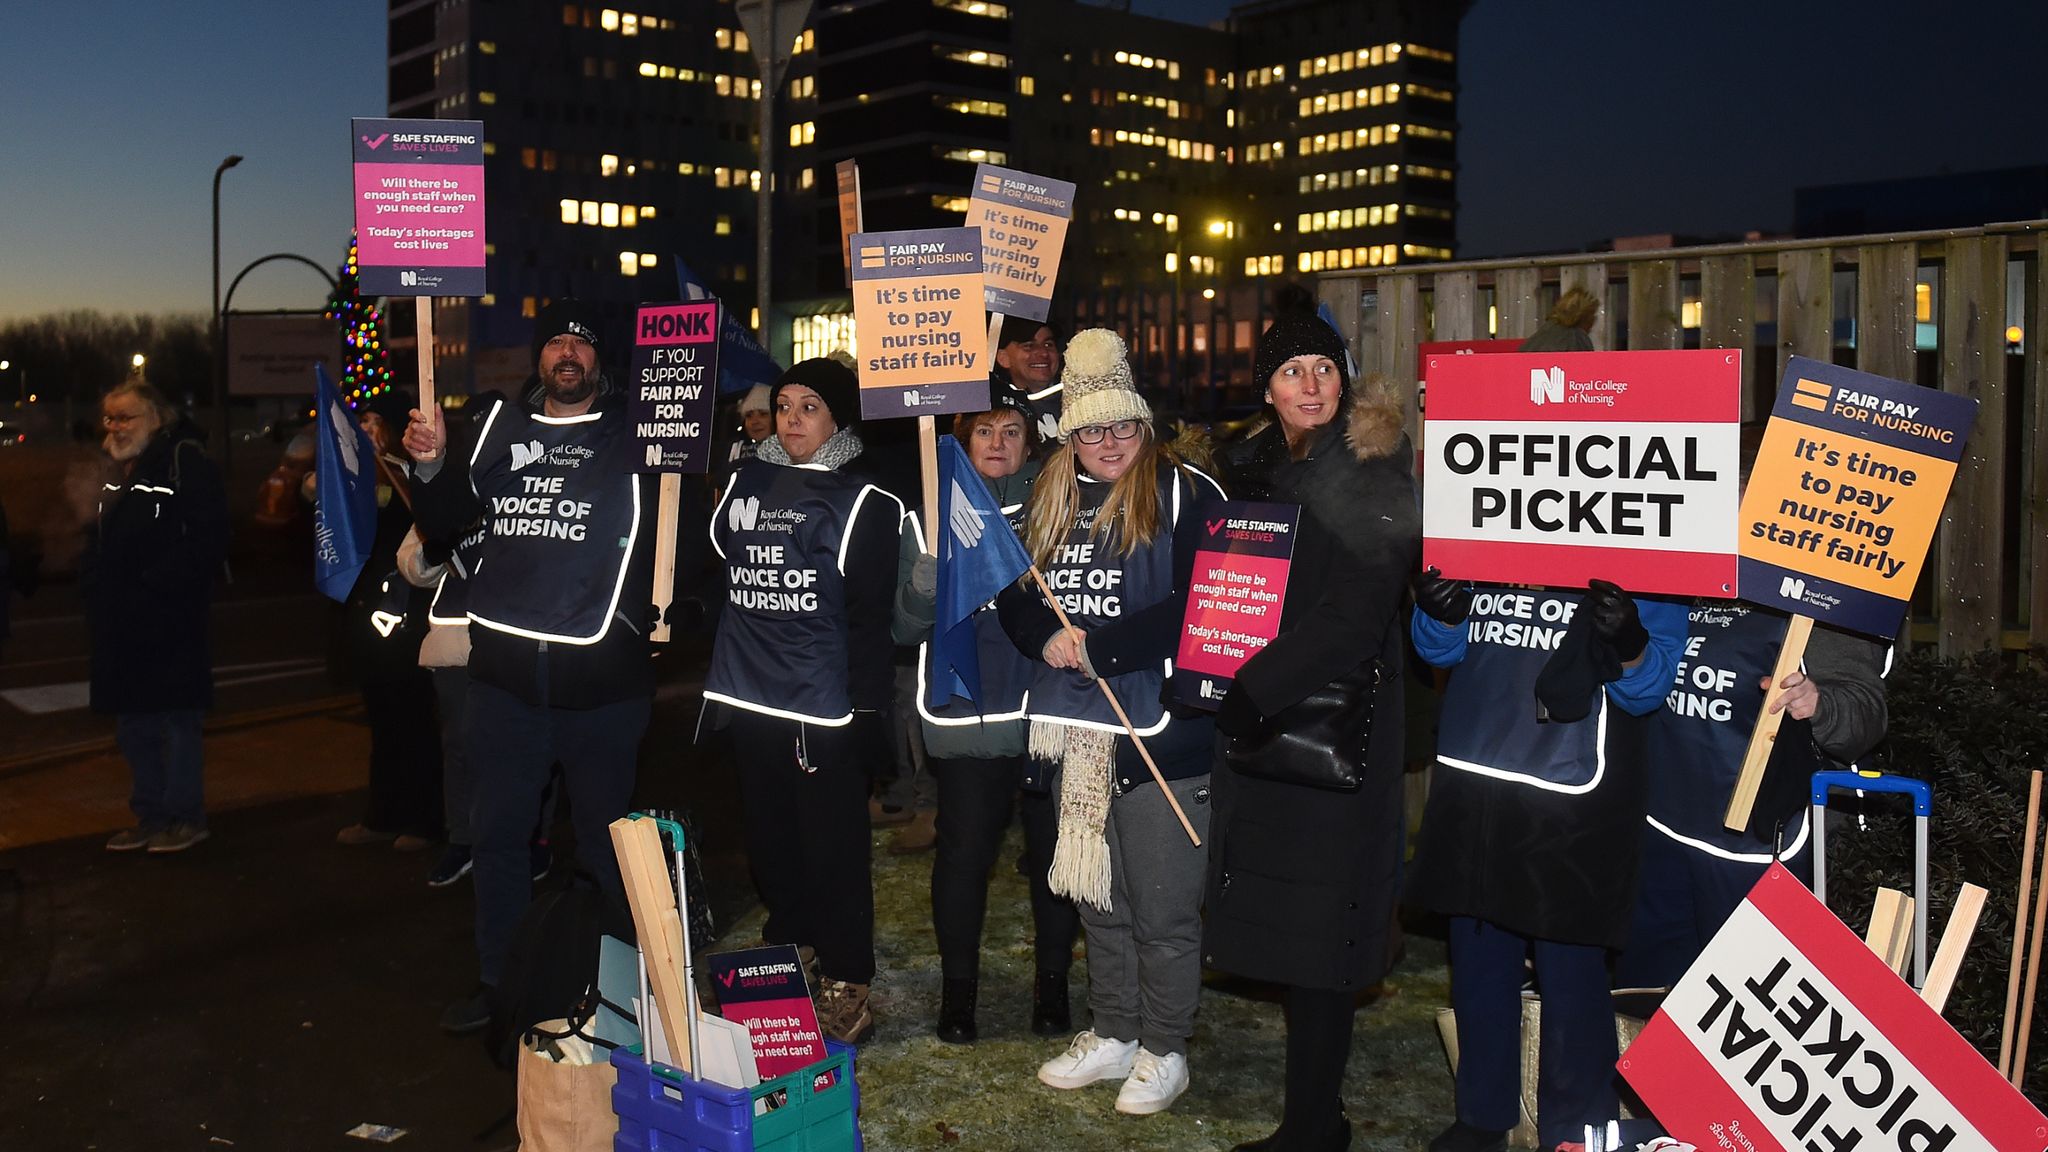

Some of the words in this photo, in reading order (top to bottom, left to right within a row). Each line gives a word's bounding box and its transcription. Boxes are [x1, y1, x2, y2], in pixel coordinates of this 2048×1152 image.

[393, 133, 421, 143] SAFE
[423, 134, 475, 144] STAFFING
[393, 144, 427, 152] SAVES
[430, 144, 458, 152] LIVES
[382, 178, 406, 188] Will
[409, 179, 440, 189] there
[444, 179, 458, 189] be
[1004, 180, 1026, 192] FAIR
[1027, 184, 1047, 195] PAY
[364, 192, 409, 202] enough
[412, 192, 440, 201] staff
[442, 192, 475, 202] when
[1002, 188, 1022, 199] FOR
[1023, 193, 1065, 209] NURSING
[376, 205, 398, 214] you
[401, 204, 430, 213] need
[433, 204, 464, 213] care?
[984, 209, 1008, 225] It's
[1012, 215, 1049, 233] time
[368, 227, 412, 238] Today's
[415, 228, 474, 239] shortages
[989, 228, 1005, 241] to
[1008, 233, 1038, 250] pay
[394, 240, 419, 249] cost
[422, 240, 448, 249] lives
[889, 245, 917, 256] FAIR
[920, 243, 945, 254] PAY
[890, 256, 916, 266] FOR
[918, 252, 974, 265] NURSING
[982, 261, 1004, 275] aff
[1006, 265, 1047, 287] fairly
[876, 287, 908, 305] It's
[912, 286, 961, 303] time
[641, 312, 710, 338] HONK
[888, 312, 909, 326] to
[915, 309, 952, 328] pay
[882, 329, 961, 349] nursing
[652, 350, 664, 364] IF
[666, 348, 695, 363] YOU
[869, 352, 918, 371] staff
[922, 350, 976, 369] fairly
[641, 366, 704, 383] SUPPORT
[640, 386, 672, 401] FAIR
[674, 385, 702, 400] PAY
[1568, 379, 1593, 391] Royal
[1594, 379, 1628, 393] College
[1568, 393, 1579, 404] of
[1580, 393, 1615, 406] Nursing
[1836, 388, 1880, 410] FAIR
[1881, 398, 1920, 419] PAY
[655, 404, 683, 419] FOR
[637, 422, 700, 438] NURSING
[1832, 403, 1868, 423] FOR
[1872, 413, 1954, 444] NURSING
[565, 444, 595, 458] College
[1443, 432, 1717, 481] OFFICIAL
[538, 455, 548, 464] of
[549, 456, 581, 469] Nursing
[1794, 437, 1840, 467] It's
[1847, 452, 1917, 487] time
[522, 476, 565, 494] THE
[1800, 470, 1831, 495] to
[1835, 483, 1894, 515] pay
[492, 497, 554, 515] VOICE
[557, 499, 592, 520] OF
[760, 509, 778, 522] Royal
[778, 509, 807, 524] College
[1075, 506, 1096, 520] oyal
[1472, 487, 1684, 537] PICKET
[493, 518, 587, 541] NURSING
[757, 522, 767, 532] of
[767, 521, 793, 535] Nursing
[1226, 519, 1248, 530] SAFE
[1249, 520, 1289, 533] STAFFING
[1779, 498, 1894, 547] nursing
[1225, 530, 1250, 540] SAVES
[1251, 532, 1274, 542] LIVES
[746, 545, 785, 565] THE
[1052, 543, 1094, 564] THE
[1750, 521, 1823, 552] staff
[1826, 538, 1906, 579] fairly
[730, 566, 780, 588] VOICE
[783, 569, 817, 588] OF
[1037, 569, 1083, 592] OICE
[1087, 569, 1123, 590] OF
[1208, 569, 1226, 580] Will
[1227, 570, 1252, 584] there
[1254, 574, 1267, 585] be
[730, 589, 818, 612] NURSING
[1193, 583, 1226, 597] enough
[1227, 585, 1250, 599] staff
[1251, 590, 1278, 603] when
[1197, 599, 1220, 612] you
[1221, 600, 1239, 613] need
[1240, 602, 1266, 616] care?
[1540, 599, 1578, 624] OF
[1688, 611, 1703, 622] of
[1188, 624, 1220, 640] Today's
[1221, 629, 1268, 647] shortages
[1202, 643, 1222, 656] cost
[1223, 644, 1244, 659] lives
[1692, 665, 1737, 693] OF
[738, 965, 759, 978] SAFE
[759, 963, 796, 975] STAFFING
[740, 976, 765, 987] SAVES
[766, 974, 788, 985] LIVES
[743, 1018, 761, 1029] Will
[763, 1016, 787, 1029] there
[788, 1016, 801, 1026] be
[770, 1030, 790, 1042] staff
[791, 1030, 818, 1041] when
[753, 1049, 764, 1058] ou
[765, 1045, 787, 1057] need
[789, 1044, 813, 1055] care?
[1744, 956, 1957, 1152] PICKET
[1697, 973, 1863, 1152] FICIAL
